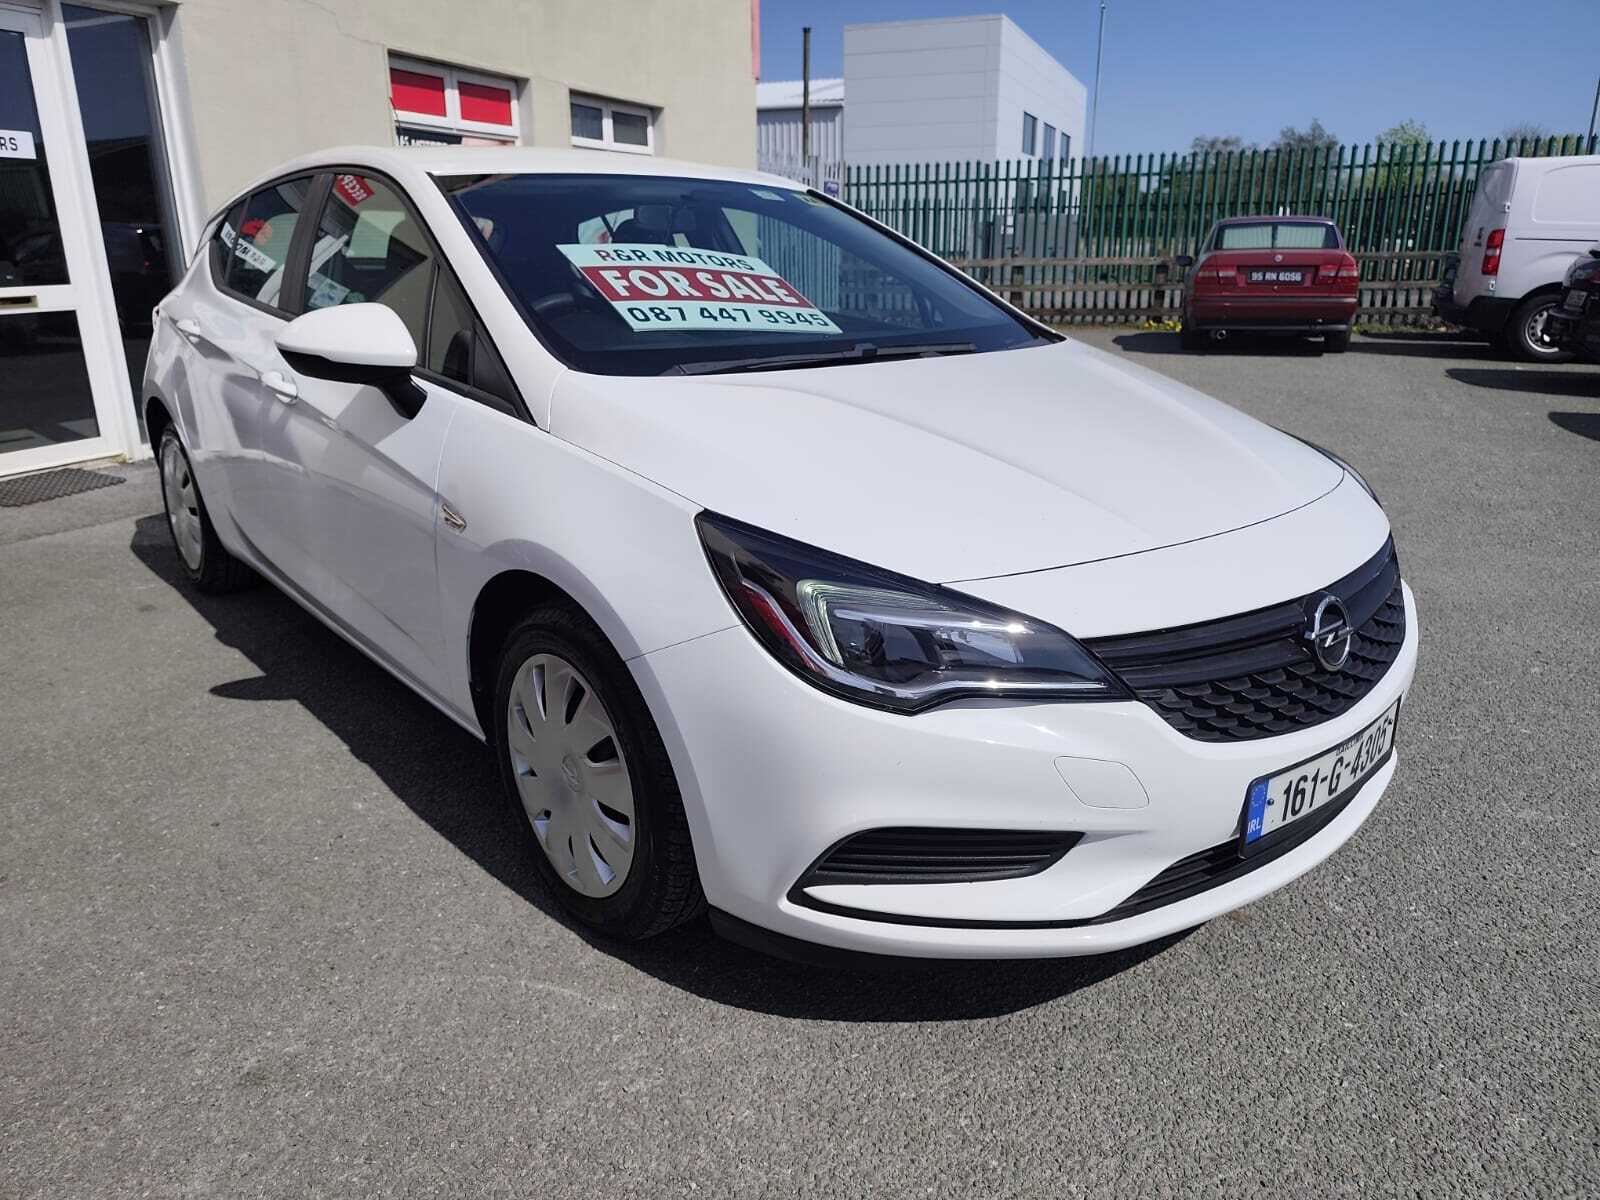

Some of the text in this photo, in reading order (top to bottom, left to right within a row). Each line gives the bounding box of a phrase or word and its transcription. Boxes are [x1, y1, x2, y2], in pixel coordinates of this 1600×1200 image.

[594, 249, 755, 271] R&R MOTORS
[598, 269, 799, 304] FOR SALE
[627, 307, 829, 327] 087 447 9945
[1281, 715, 1389, 822] 161-G-4305
[1247, 817, 1262, 834] IRL
